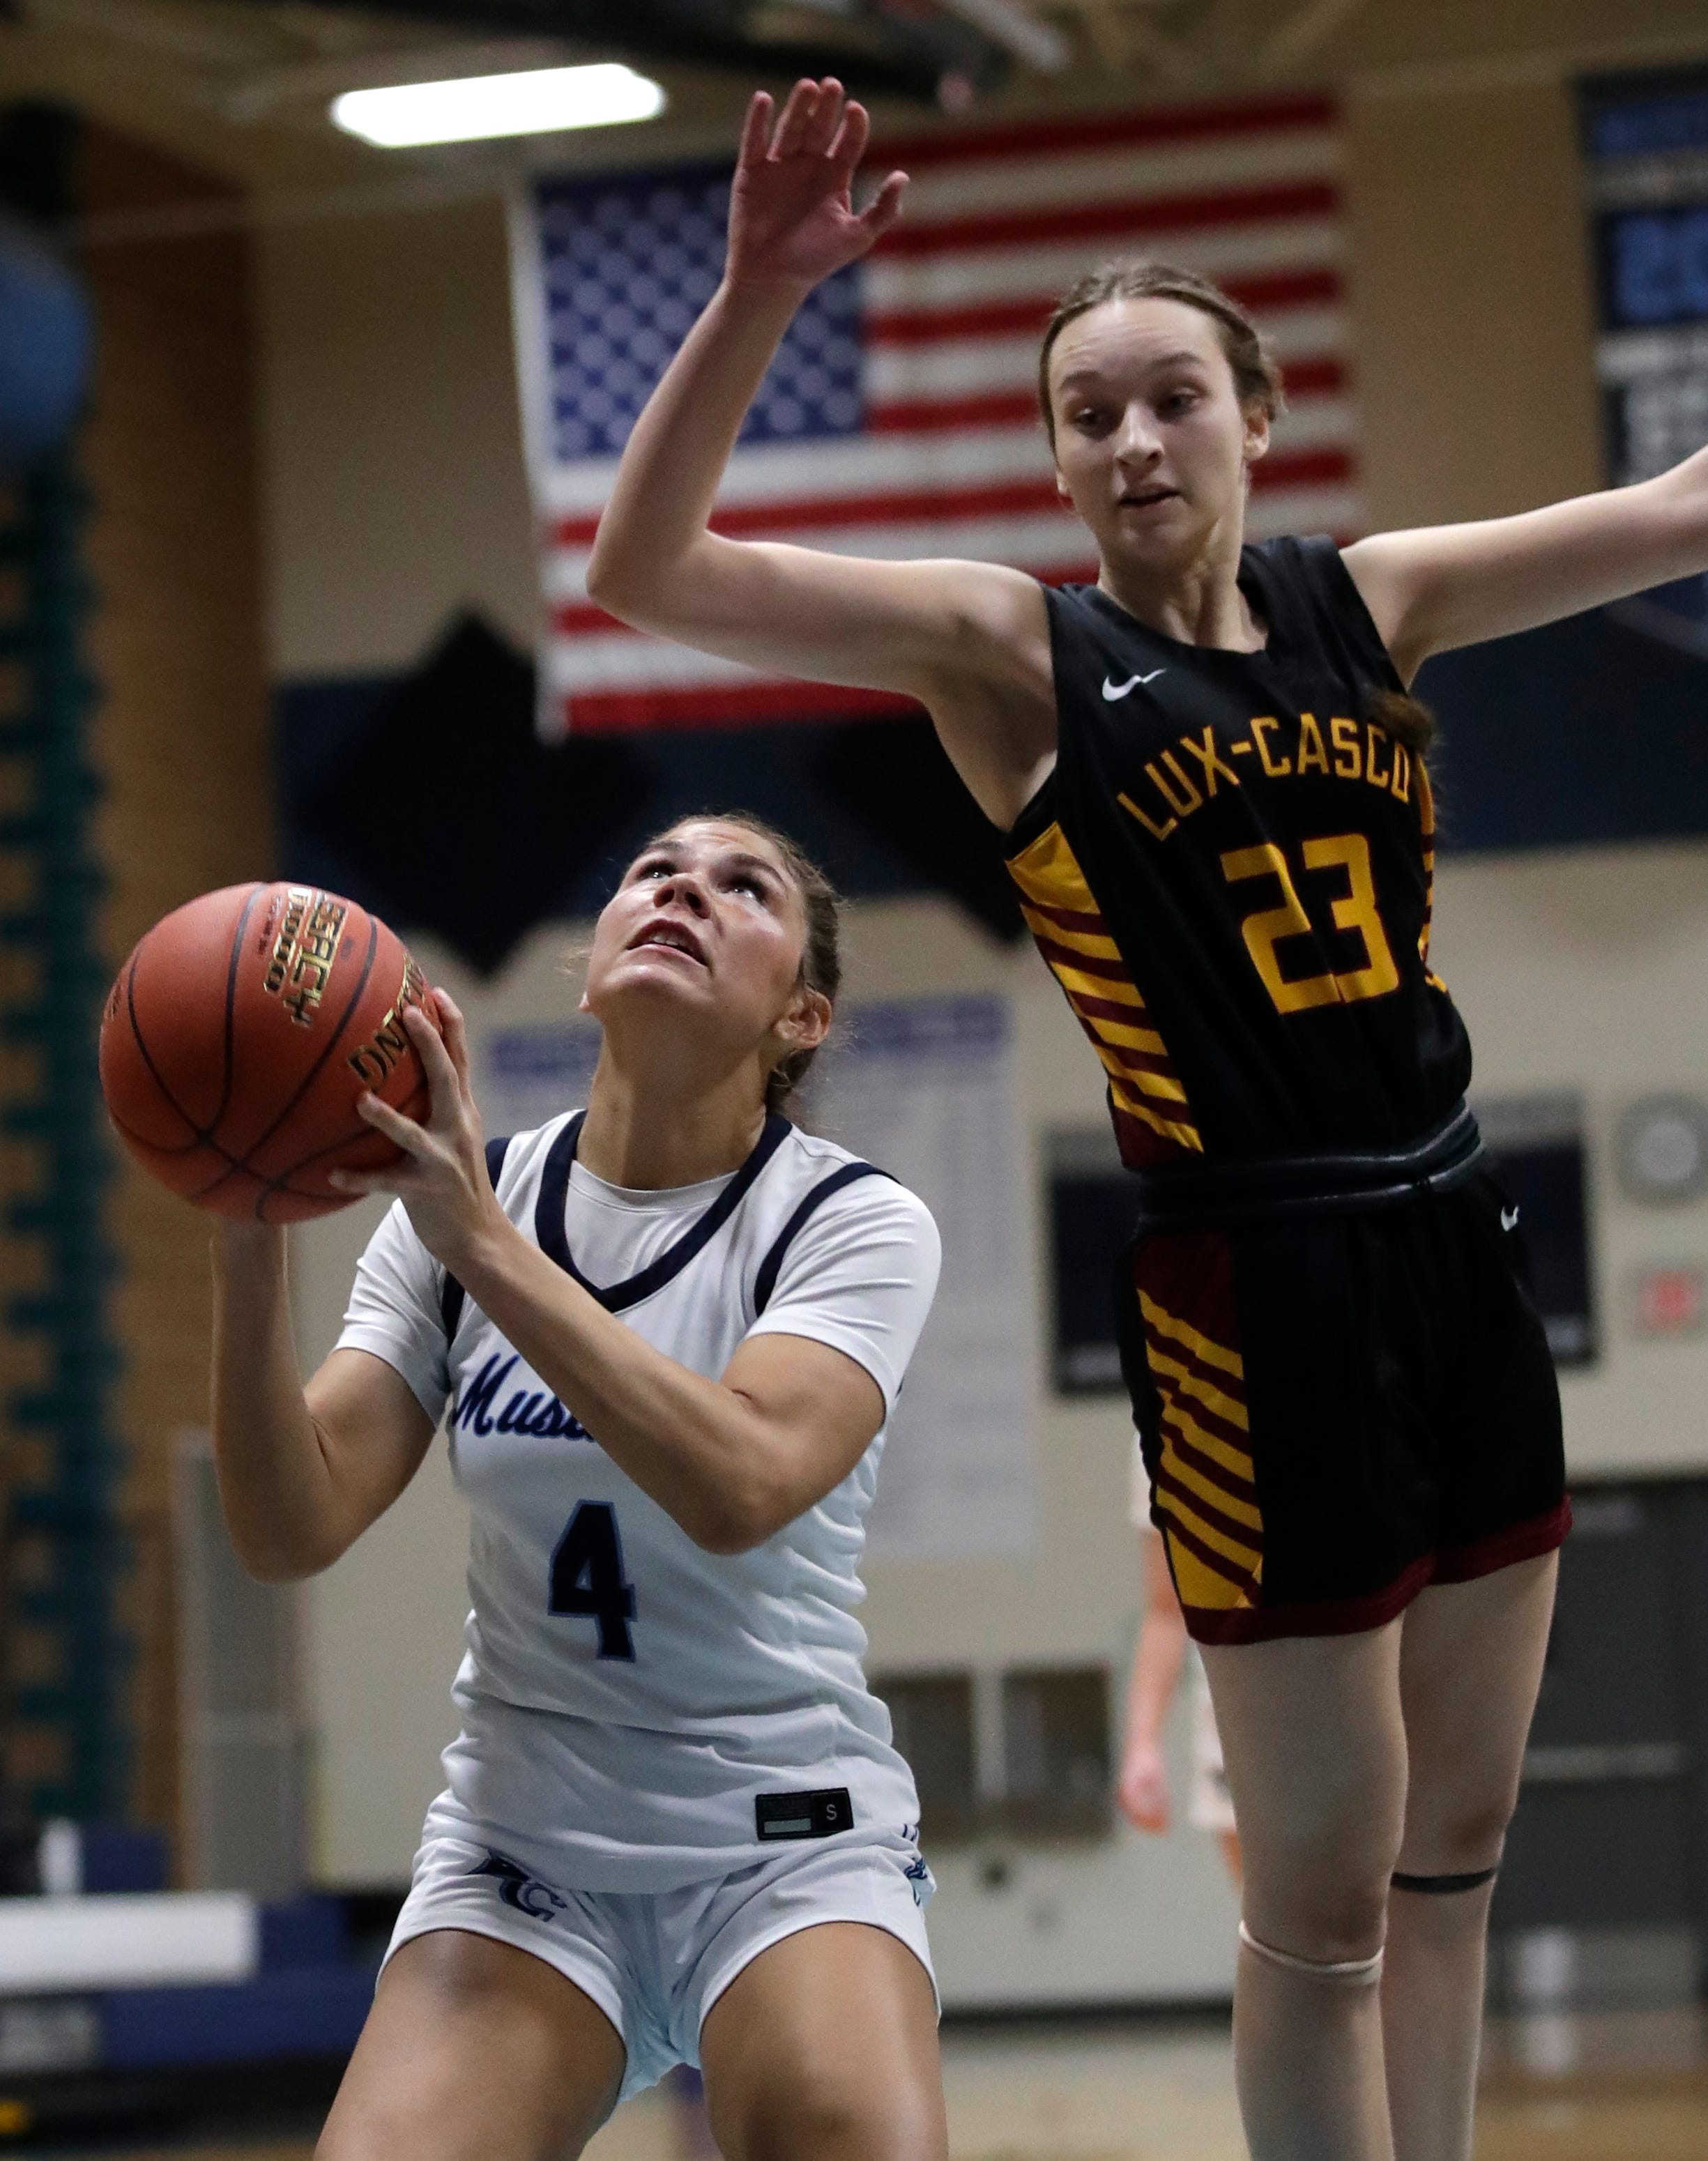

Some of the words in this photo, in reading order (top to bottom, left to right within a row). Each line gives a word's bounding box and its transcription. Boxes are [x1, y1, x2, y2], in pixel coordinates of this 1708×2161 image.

[1219, 832, 1399, 1015] 23
[547, 1499, 638, 1663] 4
[825, 1803, 838, 1821] S
